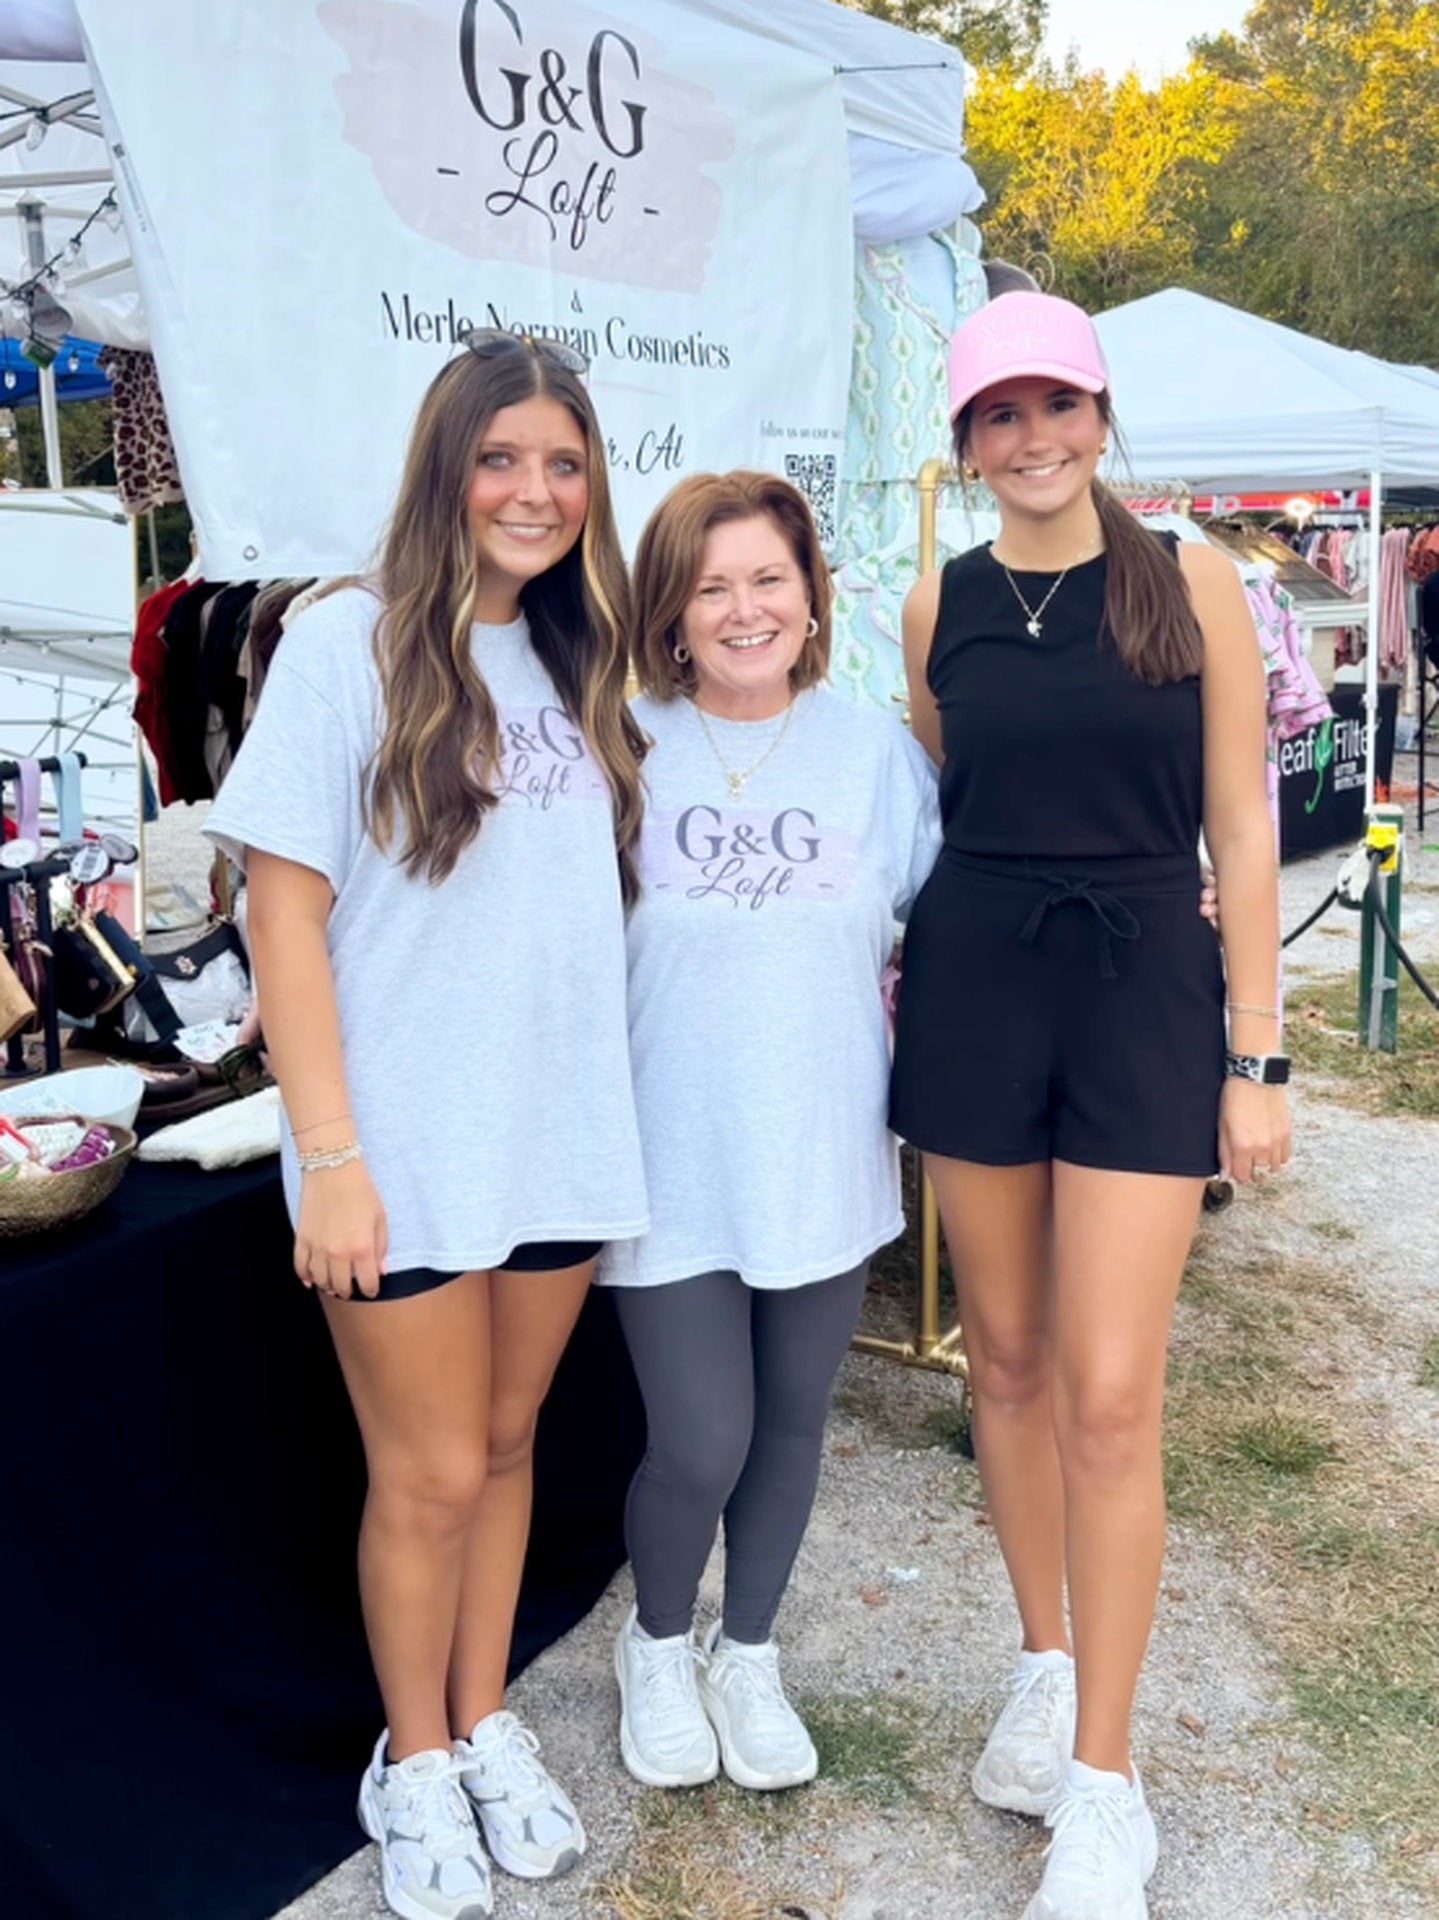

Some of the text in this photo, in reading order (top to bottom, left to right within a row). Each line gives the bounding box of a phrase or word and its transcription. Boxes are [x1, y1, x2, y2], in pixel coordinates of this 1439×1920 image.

[459, 0, 647, 158] G&G
[485, 129, 617, 250] Loft
[381, 291, 474, 344] Merle
[605, 316, 731, 369] Cosmetics
[570, 289, 583, 313] &
[499, 706, 585, 761] &G
[495, 753, 570, 811] Loft
[675, 804, 822, 863] G&G
[685, 856, 795, 910] Loft
